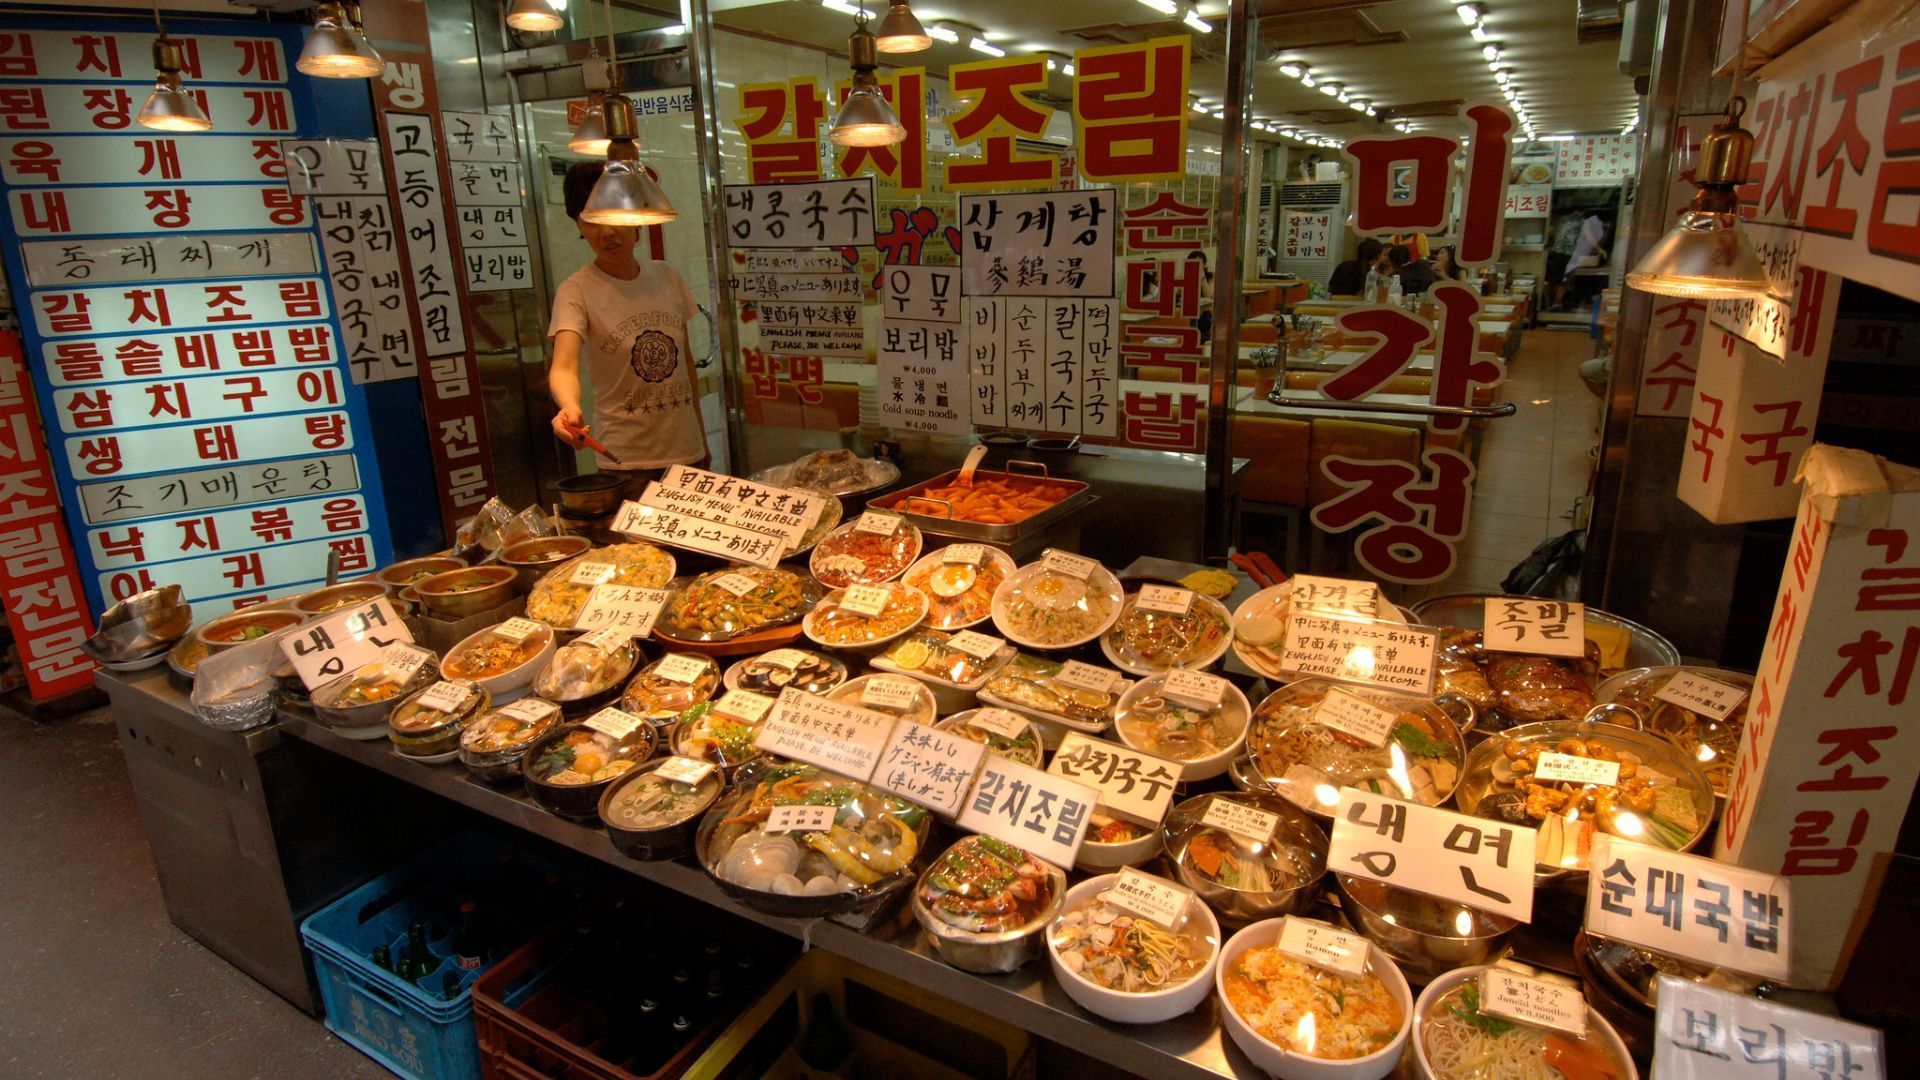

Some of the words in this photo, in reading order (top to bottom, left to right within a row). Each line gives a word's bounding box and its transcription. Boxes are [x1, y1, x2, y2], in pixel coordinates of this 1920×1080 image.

[0, 87, 290, 131] 된장개
[380, 62, 426, 109] 생
[735, 35, 1191, 193] 갈치조림
[394, 126, 451, 343] 고등어조림
[463, 208, 517, 241] 냉면
[727, 187, 869, 240] 냉콩국수
[965, 197, 1106, 253] 삼계탕
[57, 240, 270, 278] 동태찌개
[468, 254, 527, 284] 보리밥
[42, 281, 324, 333] 갈치조림
[1121, 192, 1209, 448] 순대국밥
[54, 326, 332, 382] 돌솥비빔밥
[883, 328, 958, 361] 보리밥
[976, 301, 998, 416] 비빔밥
[1050, 303, 1080, 427] 칼국수
[1085, 304, 1112, 425] 떡만두국
[1310, 100, 1517, 586] 미가정
[67, 368, 338, 430] 삼치구이
[883, 403, 901, 414] Cold
[904, 407, 926, 418] soup
[928, 408, 958, 421] noodle
[77, 414, 346, 475] 생태탕
[102, 460, 332, 516] 조기매운탕
[99, 498, 364, 565] 낙지볶음
[294, 603, 397, 676] 냉면
[1496, 602, 1575, 641] 족발
[973, 771, 1087, 847] 갈치조림
[1347, 801, 1513, 904] 냉면
[1600, 858, 1784, 954] 순대국밥
[1672, 1008, 1864, 1080] 보리밥
